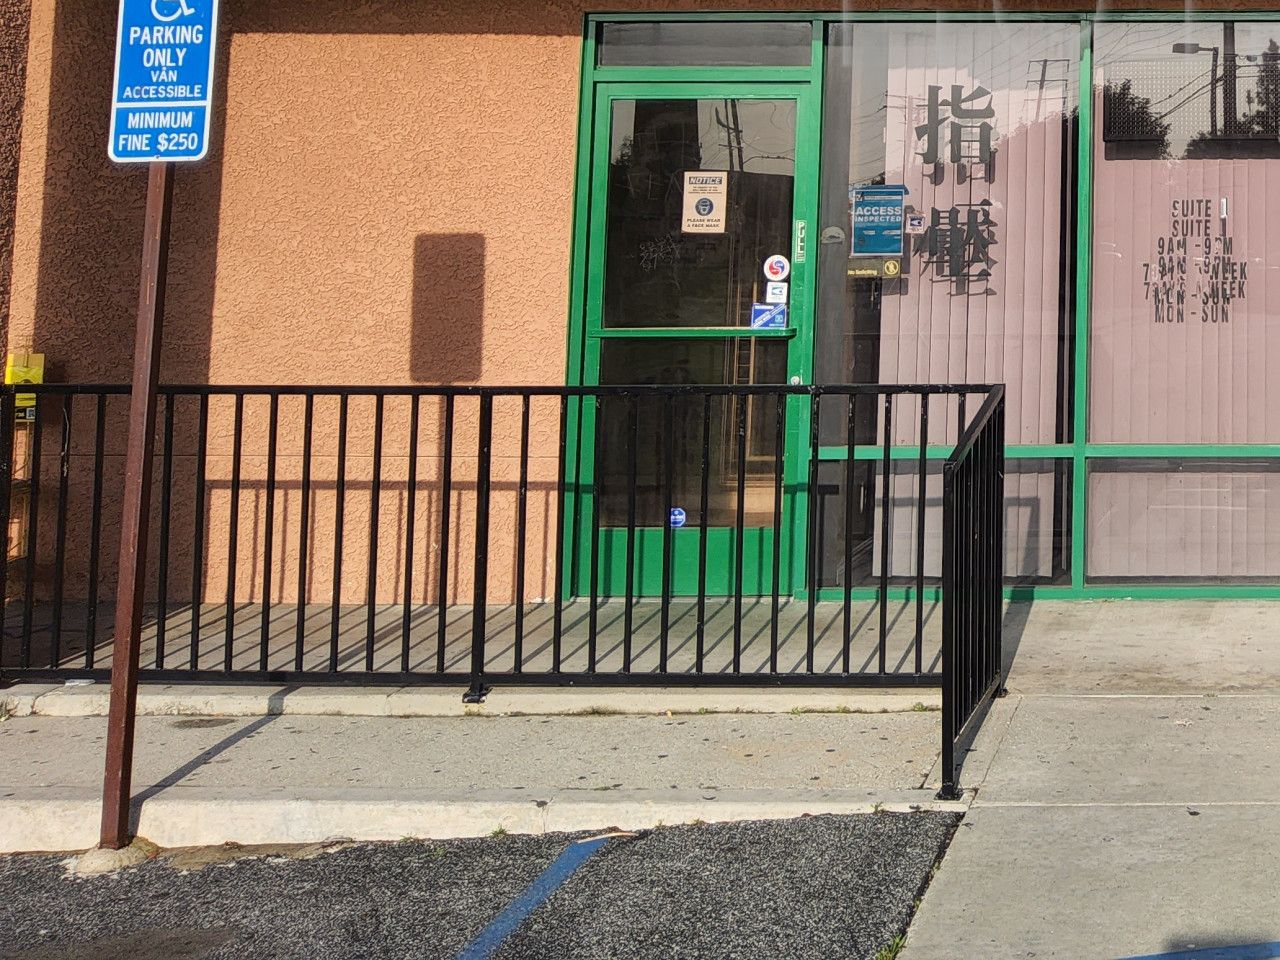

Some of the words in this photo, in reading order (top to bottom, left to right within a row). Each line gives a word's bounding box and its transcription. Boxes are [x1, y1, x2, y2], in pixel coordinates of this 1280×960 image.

[129, 25, 204, 45] PARKING
[143, 48, 187, 67] ONLY
[151, 70, 177, 82] VAN
[123, 85, 202, 99] ACCESSIBLE
[127, 111, 193, 129] MINIMUM
[118, 134, 152, 151] FINE
[156, 132, 199, 152] $250
[855, 207, 902, 215] ACCESS
[1172, 199, 1211, 218] SUITE
[797, 221, 806, 254] PULL
